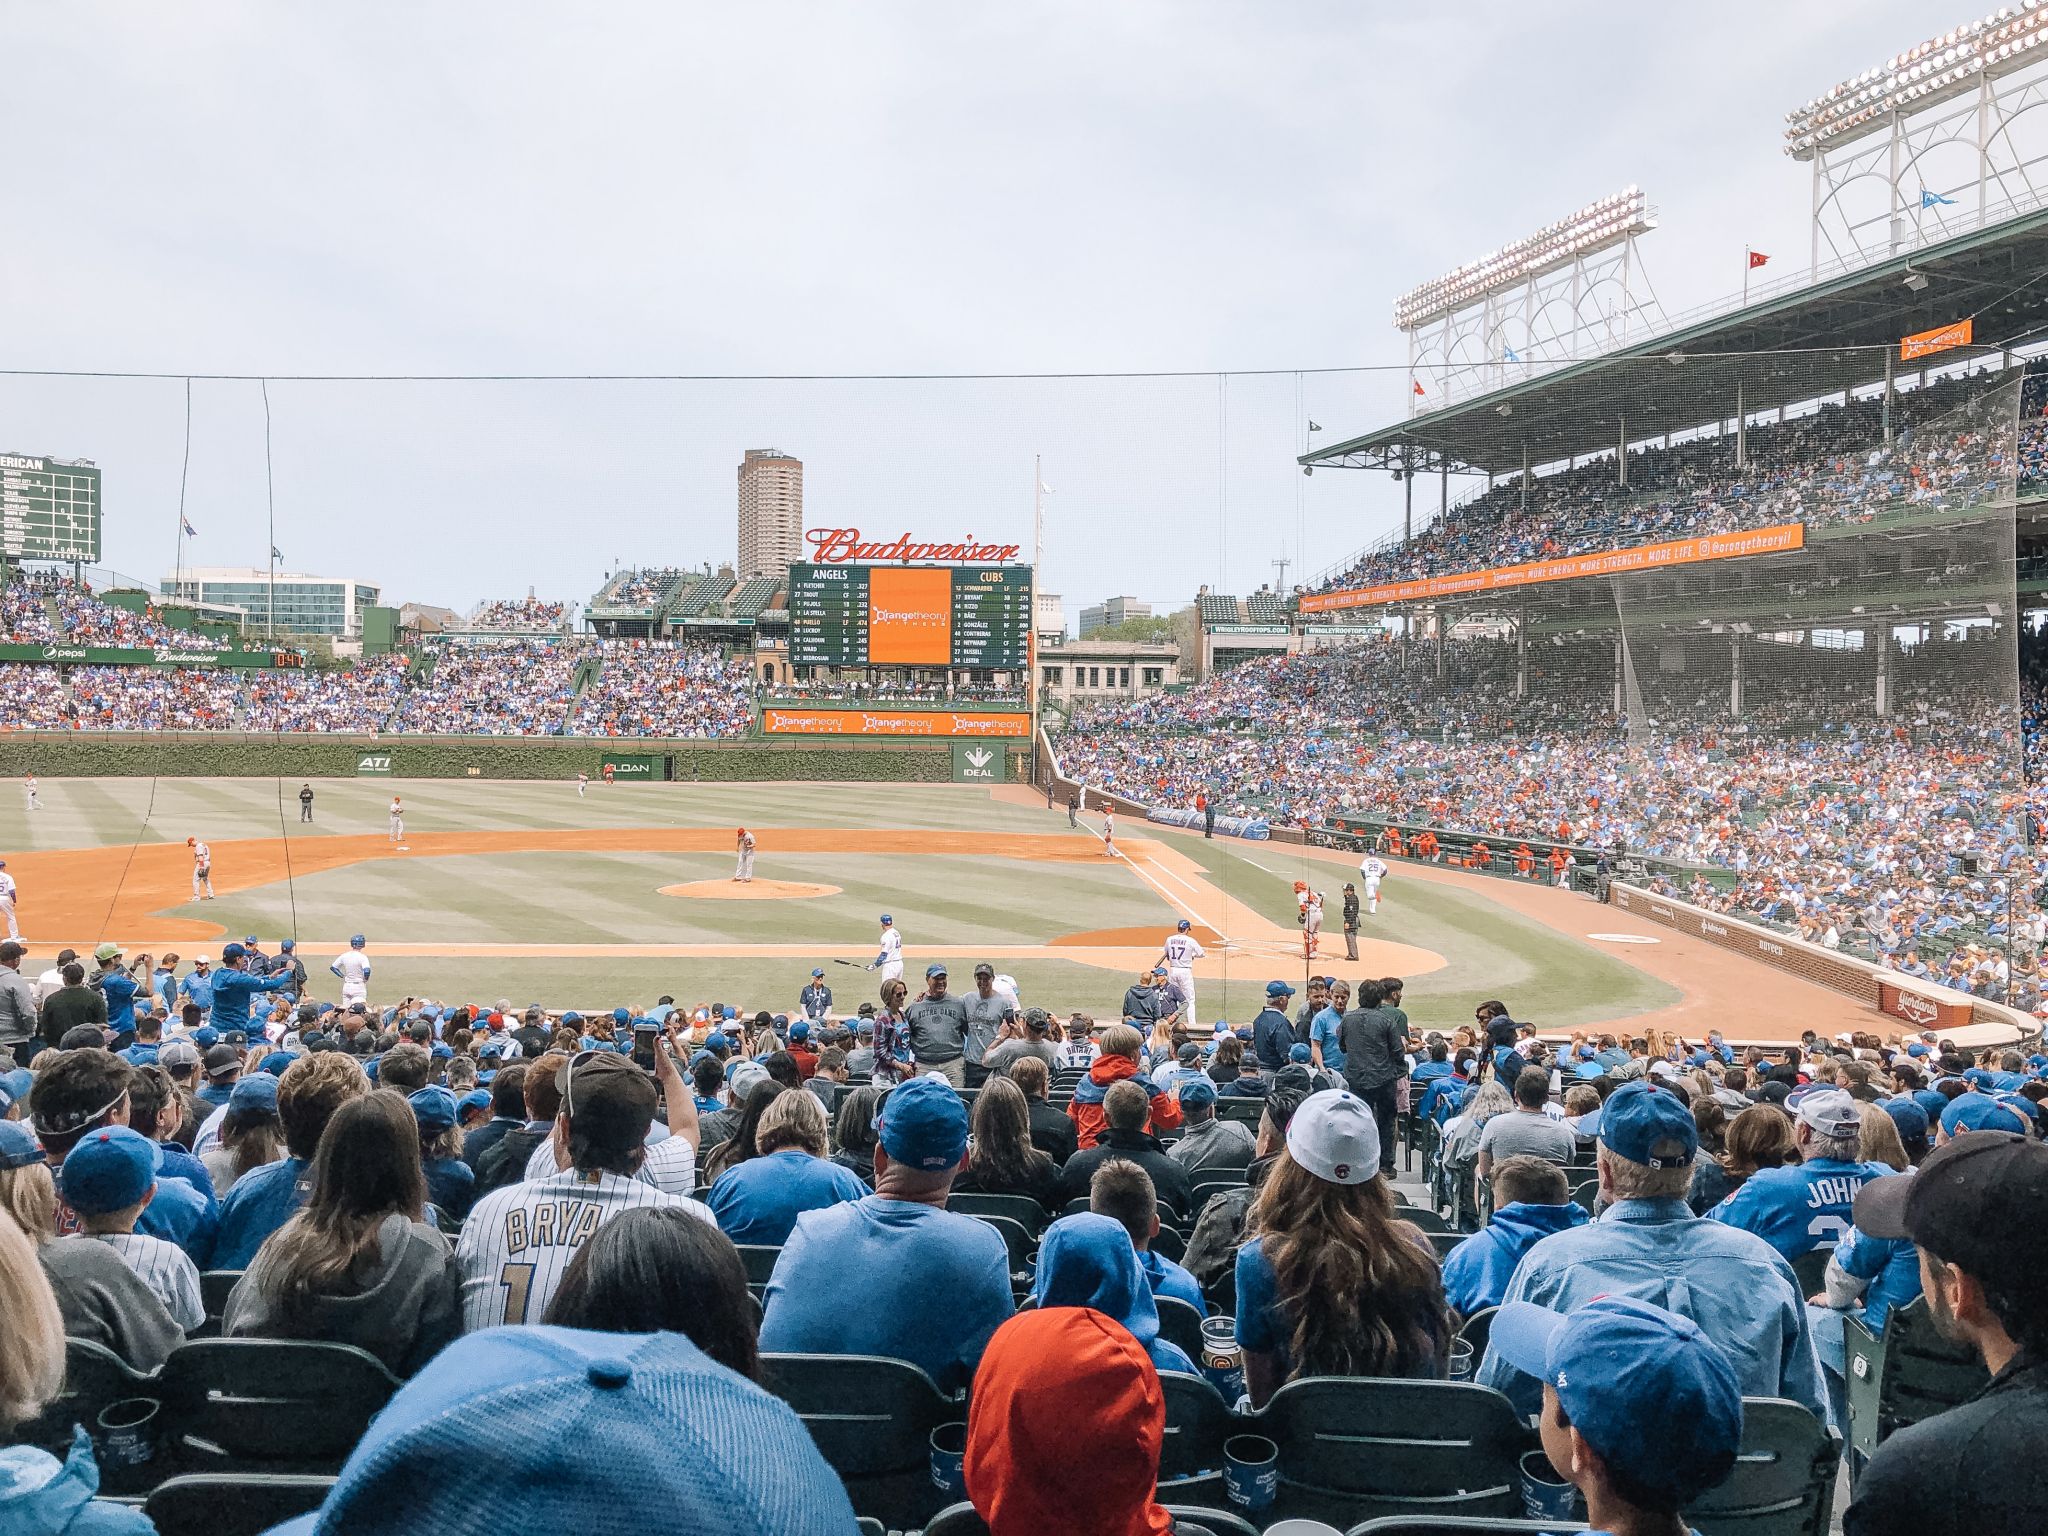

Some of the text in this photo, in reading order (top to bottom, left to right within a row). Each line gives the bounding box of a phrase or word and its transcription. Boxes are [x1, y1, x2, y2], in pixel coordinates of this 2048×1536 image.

[805, 528, 1020, 563] Budweiser
[1528, 567, 1546, 578] MORE
[1580, 559, 1600, 570] MORE
[1648, 549, 1671, 561] MORE
[813, 570, 848, 579] ANGELS
[981, 572, 1003, 582] CUBS
[1215, 626, 1286, 634] WRIGLEYROOFTOPS.COM
[1308, 626, 1382, 634] WRIGLEYROOFTOPS.COM
[58, 649, 86, 659] pepsi
[154, 650, 218, 663] Budweiser
[358, 757, 391, 767] ATI
[614, 764, 649, 772] LOAN
[963, 768, 994, 777] IDEAL
[1368, 863, 1379, 871] 25
[1759, 940, 1783, 955] nuveen
[1170, 946, 1186, 961] 17
[1898, 990, 1938, 1018] Giordano's
[918, 1007, 937, 1019] NOTRE
[940, 1007, 957, 1019] DAME
[1066, 1045, 1094, 1056] BRYANT
[1067, 1056, 1092, 1067] 17
[505, 1200, 604, 1256] BRYA
[500, 1262, 537, 1325] 1
